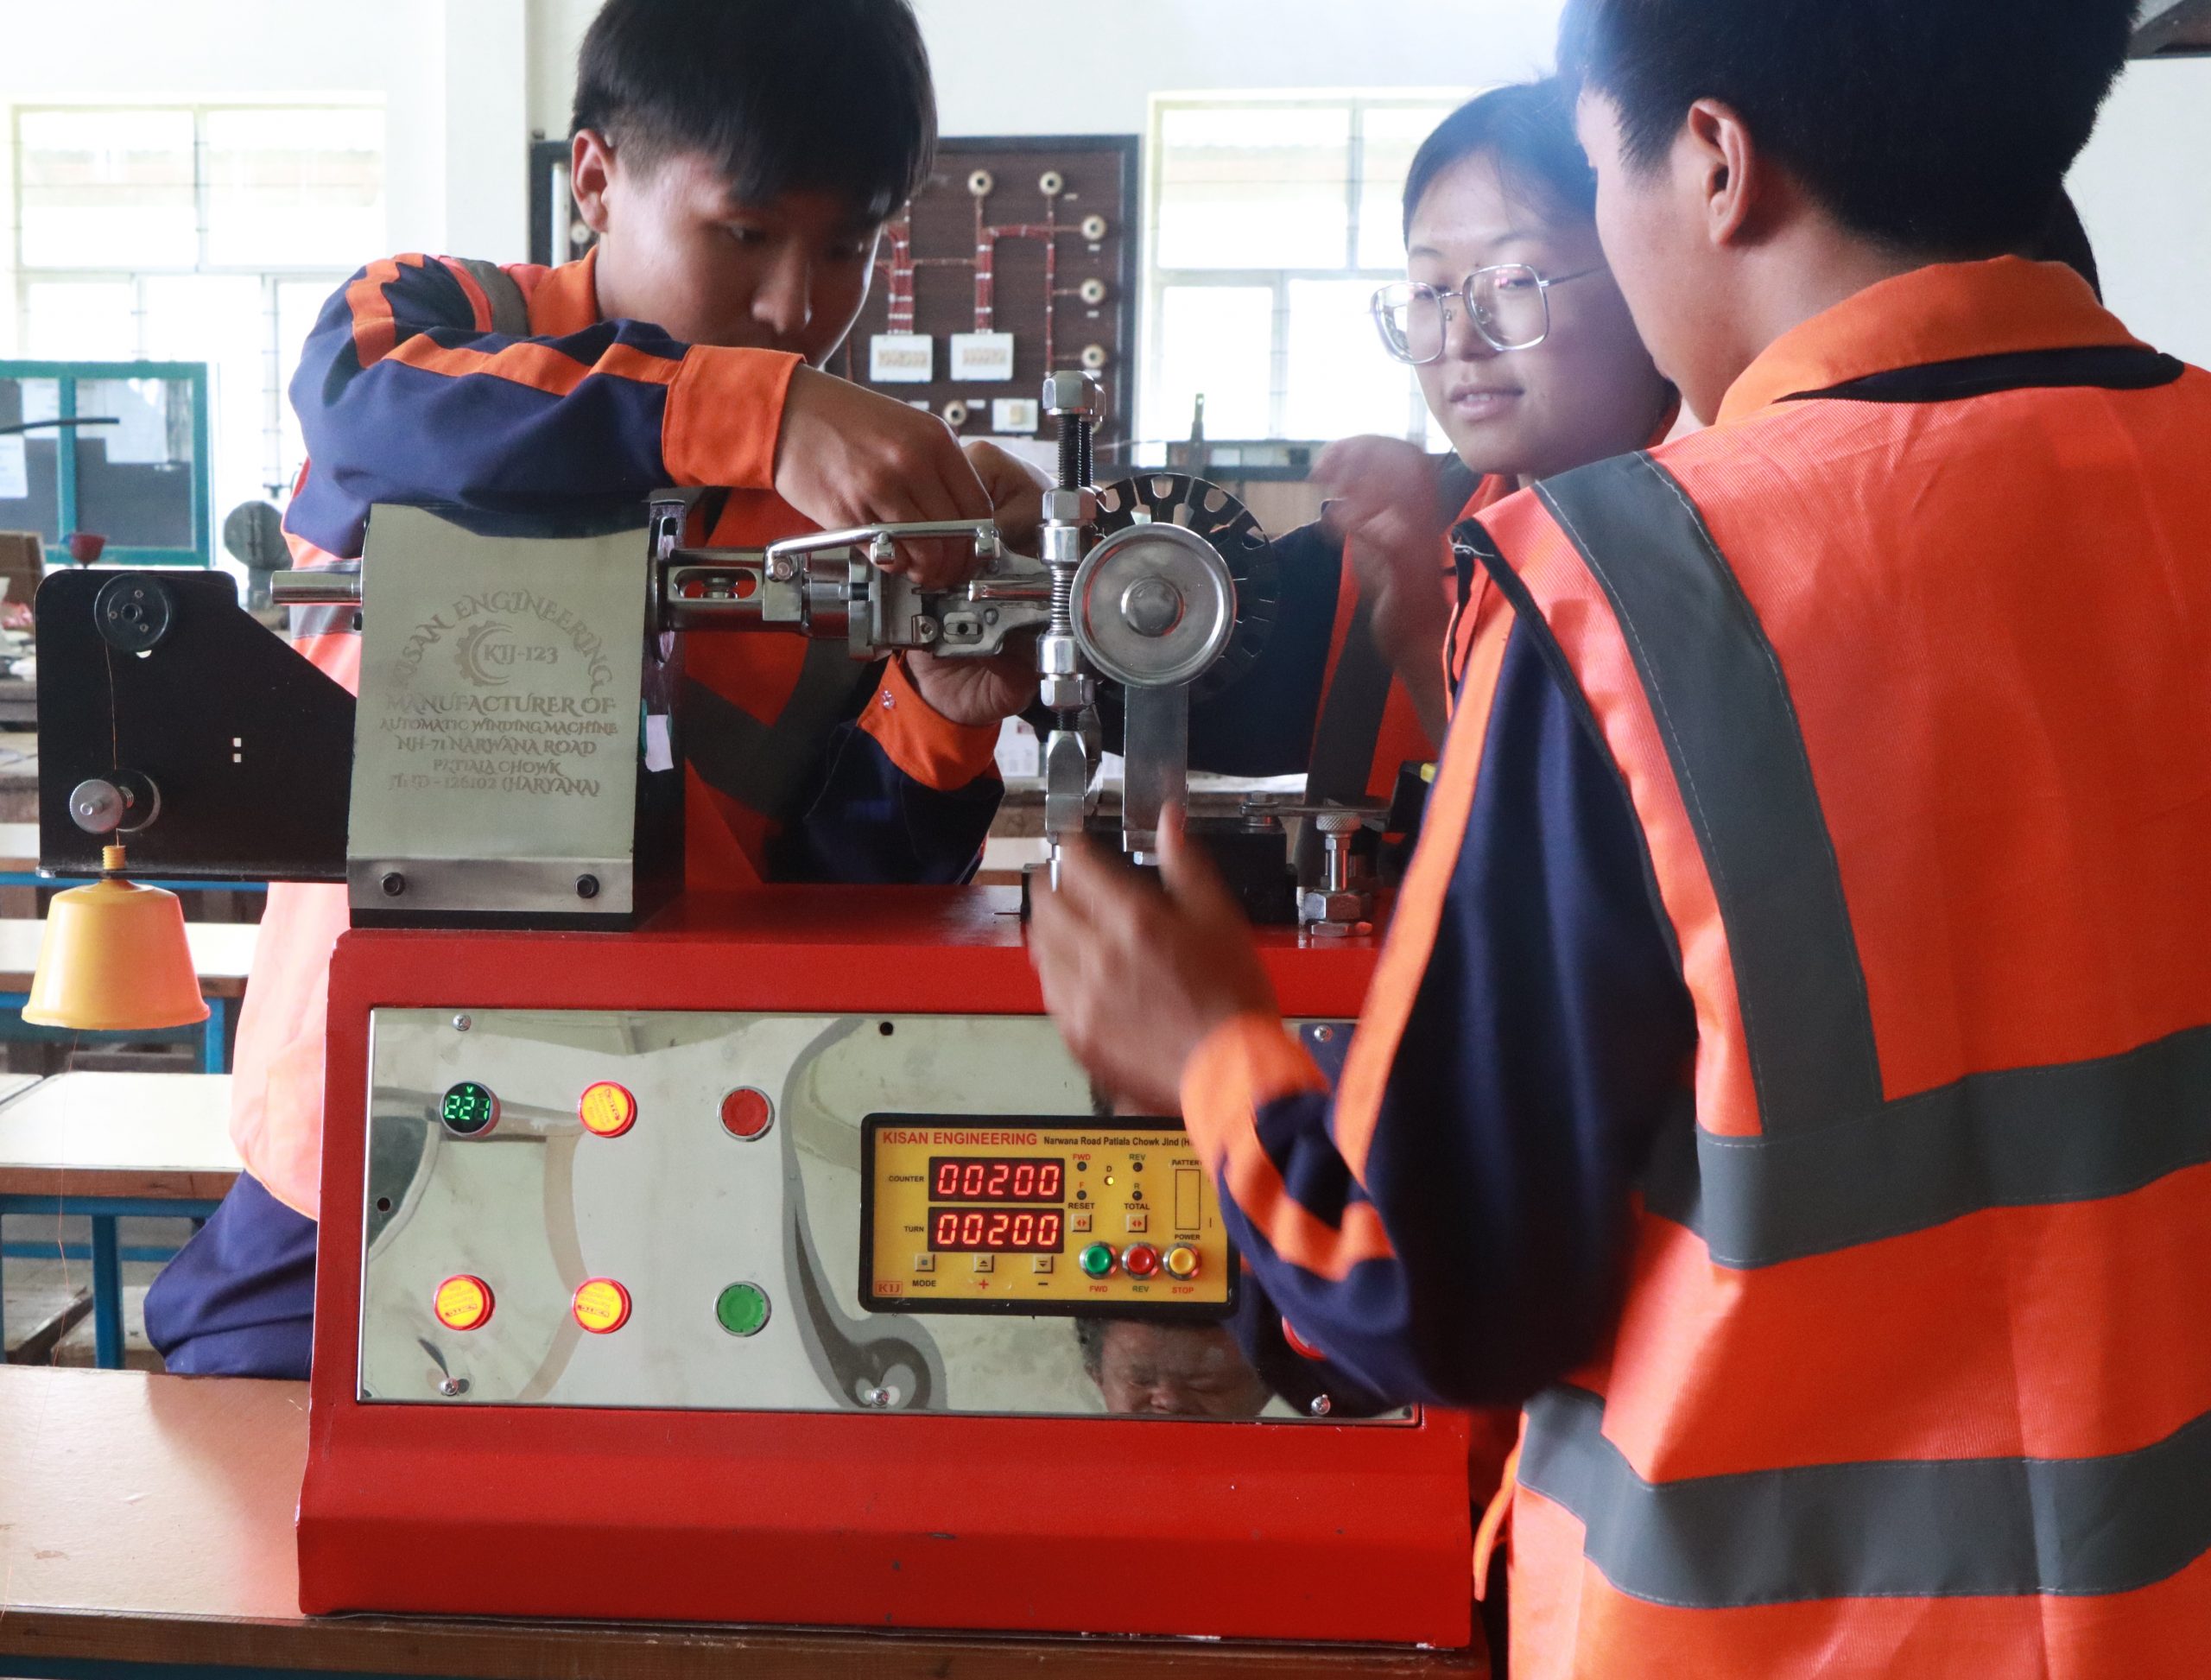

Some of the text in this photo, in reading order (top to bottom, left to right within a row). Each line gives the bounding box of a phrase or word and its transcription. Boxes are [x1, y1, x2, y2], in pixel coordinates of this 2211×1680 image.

[454, 588, 612, 694] ENGINEERING
[484, 644, 558, 665] KIJ-123
[386, 691, 616, 717] MANUFACTURER OF
[380, 717, 618, 736] AUTOMATIC WINDING MACHINE
[395, 734, 598, 758] NH-71 NARWANA ROAD
[498, 759, 565, 777] CHOWK
[503, 775, 601, 796] (HARYANA)
[445, 1095, 490, 1120] 221
[883, 1132, 1037, 1145] KISAN ENGINEERING
[1043, 1137, 1079, 1145] Narwana
[1080, 1137, 1101, 1145] Road
[1104, 1137, 1131, 1146] Patiala
[1132, 1138, 1160, 1146] Chowk
[1162, 1138, 1179, 1146] Jind
[937, 1164, 1060, 1195] 00200
[937, 1214, 1059, 1245] 00200
[878, 1283, 901, 1293] KIJ
